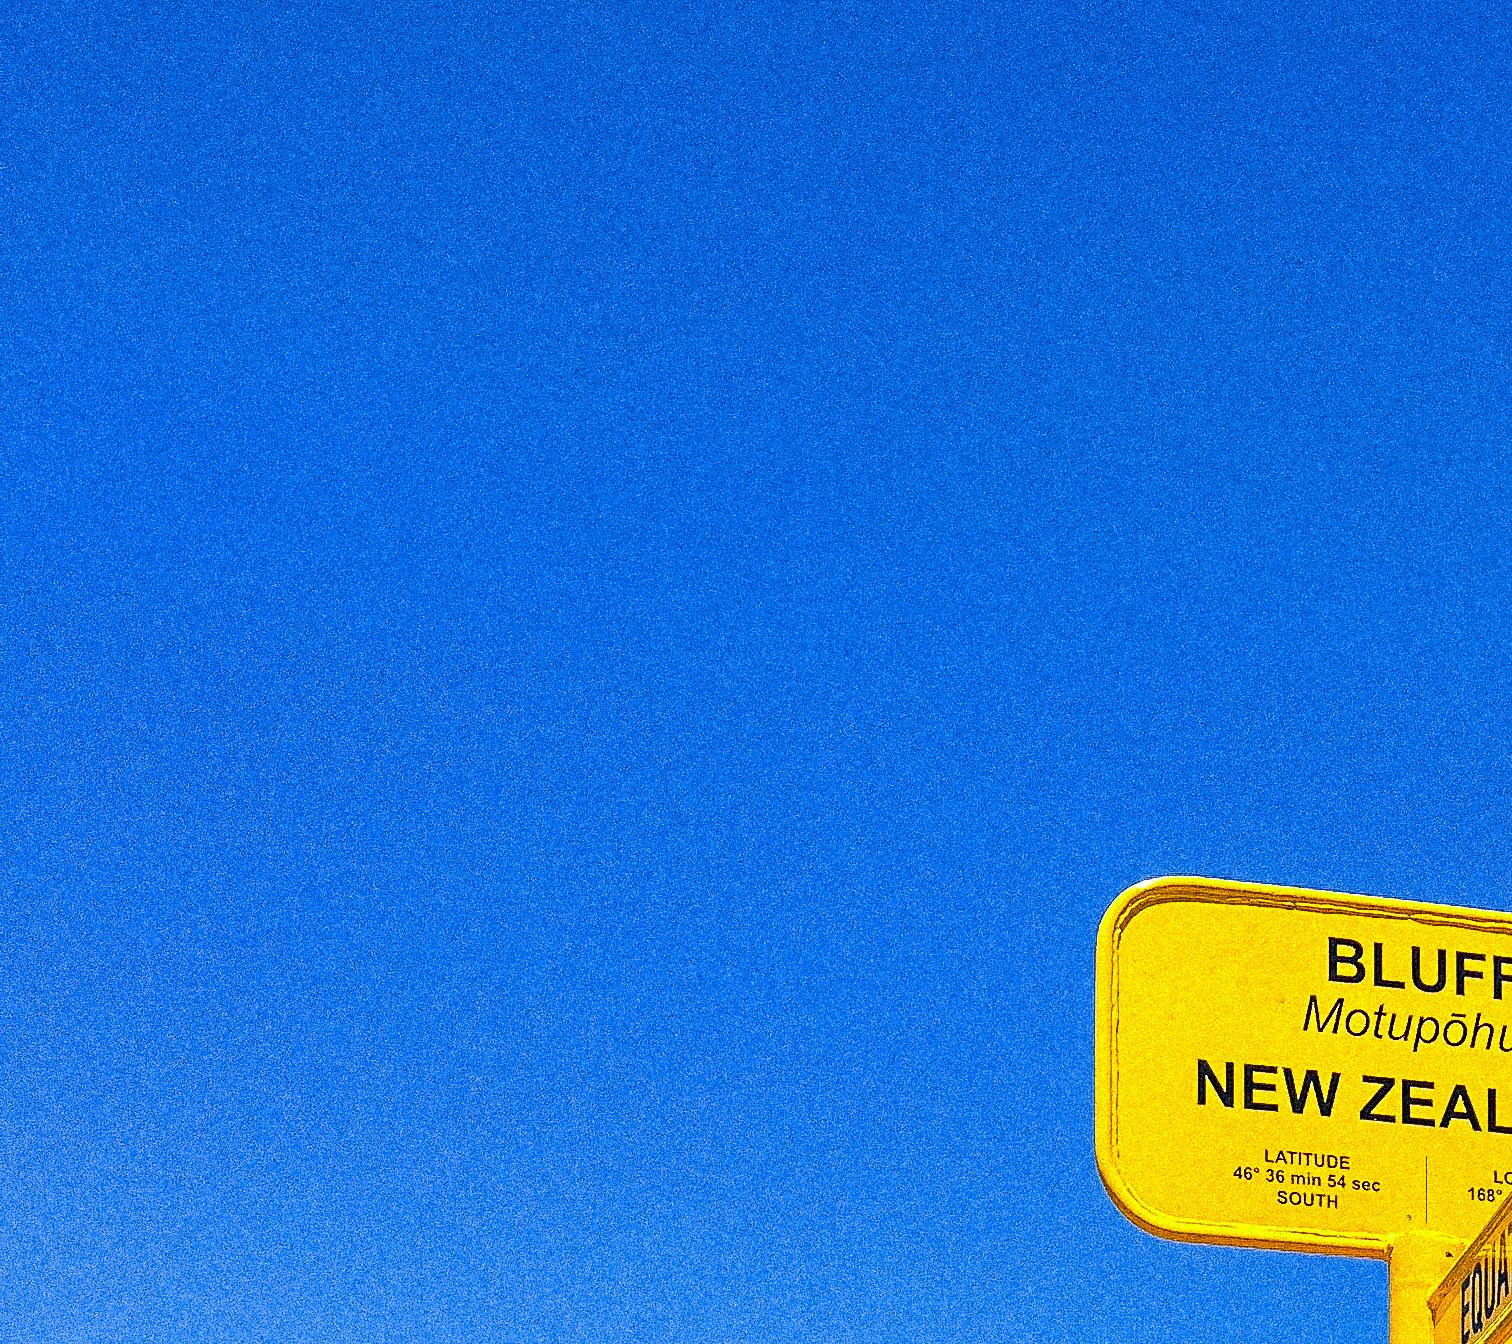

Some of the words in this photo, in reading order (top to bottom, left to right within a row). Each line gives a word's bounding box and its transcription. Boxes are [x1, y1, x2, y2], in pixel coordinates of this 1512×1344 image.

[1197, 1058, 1341, 1117] NEW
[1264, 1149, 1350, 1170] LATITUDE
[1232, 1166, 1260, 1182] 46°
[1265, 1168, 1285, 1184] 36
[1290, 1173, 1322, 1188] min
[1327, 1174, 1347, 1189] 54
[1351, 1179, 1381, 1193] sec
[1276, 1190, 1338, 1209] SOUTH
[1467, 1187, 1503, 1203] 168°
